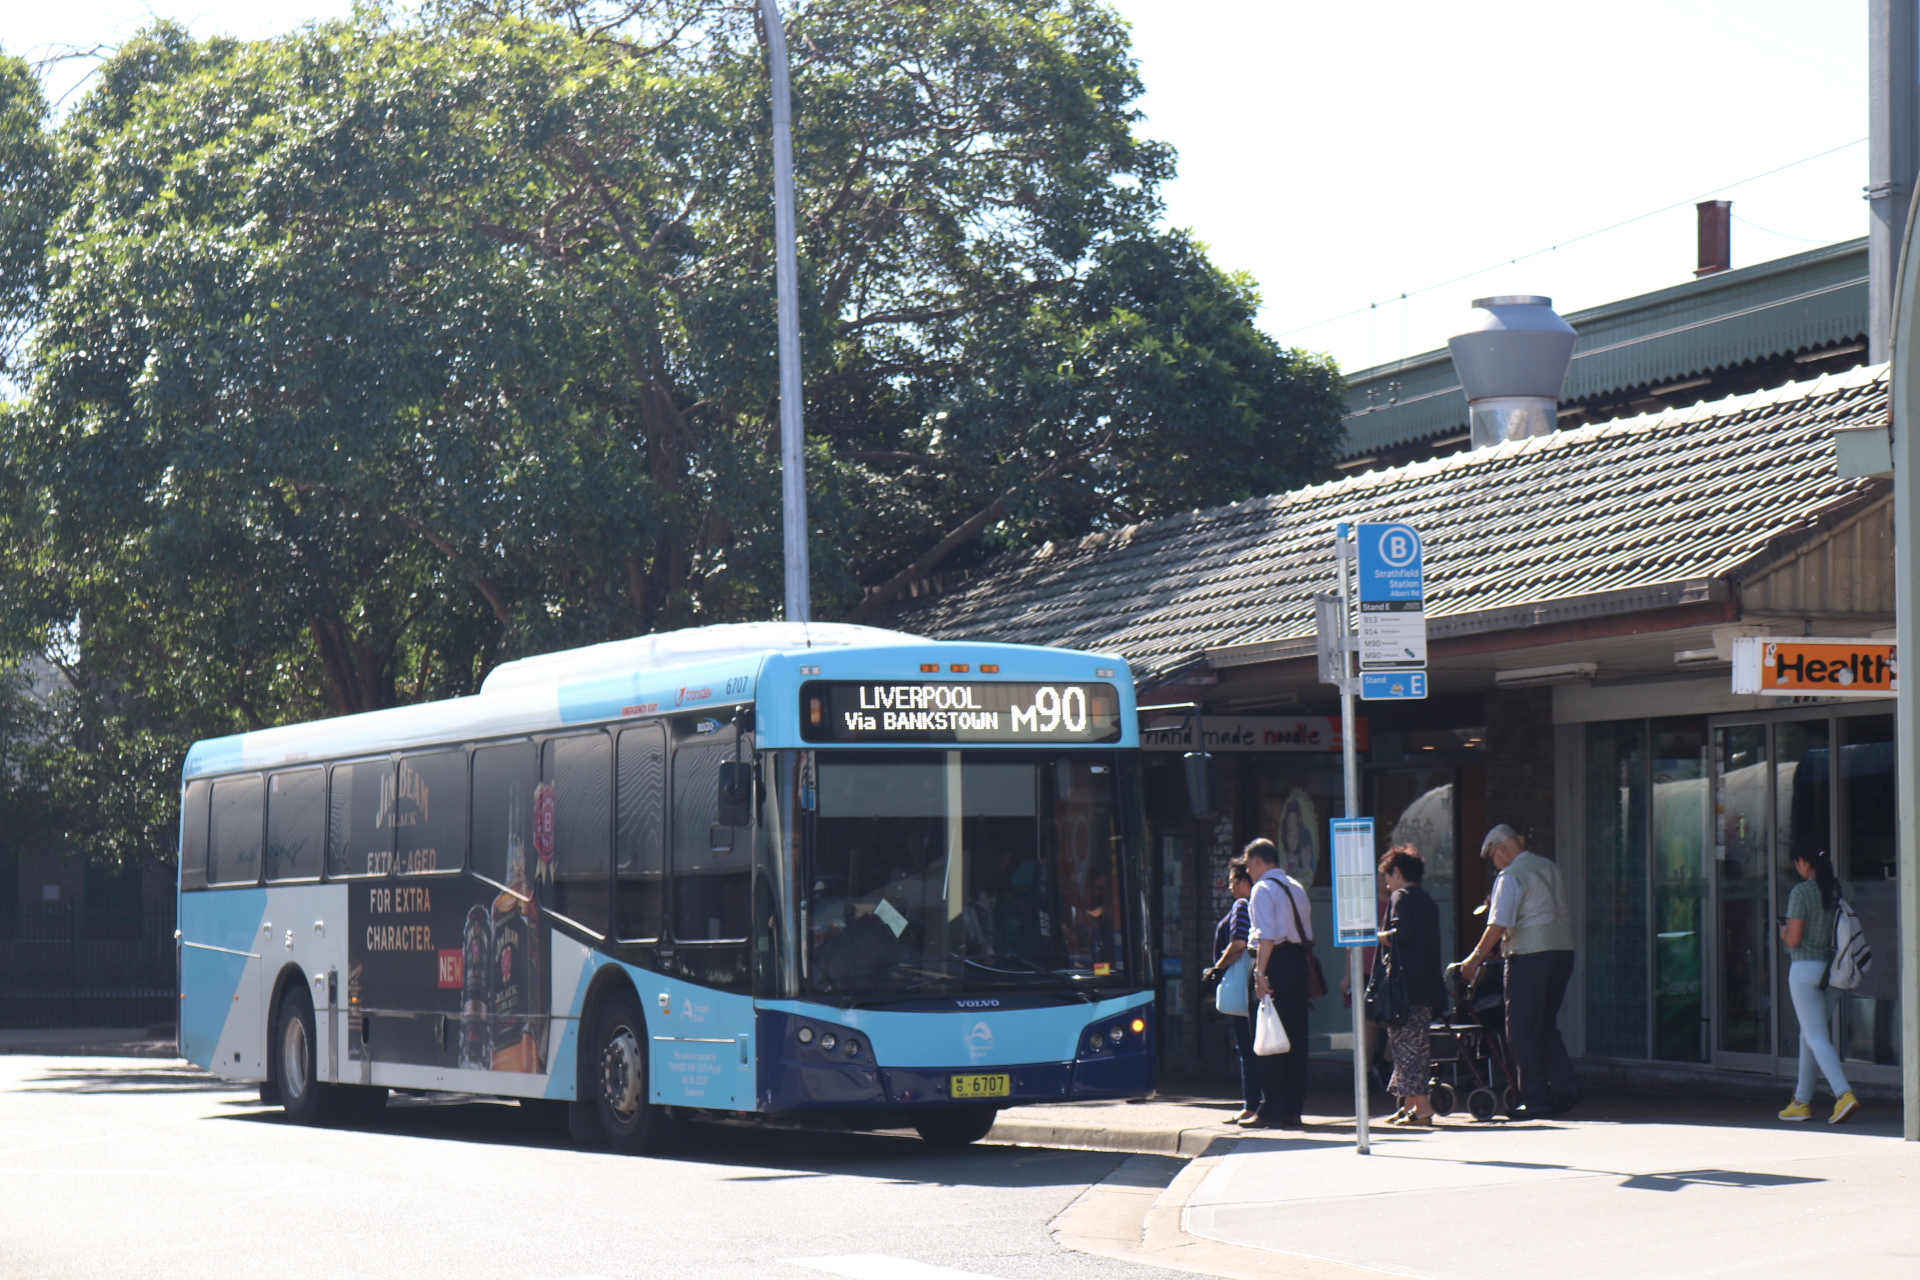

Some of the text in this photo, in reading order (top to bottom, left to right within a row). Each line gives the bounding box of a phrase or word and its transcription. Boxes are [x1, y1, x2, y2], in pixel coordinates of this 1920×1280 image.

[1391, 536, 1407, 559] B
[1374, 569, 1419, 579] Strathfield
[1389, 579, 1420, 589] Station
[1390, 590, 1410, 598] Albert
[1362, 602, 1391, 611] Stand E
[1363, 616, 1378, 624] 913
[1364, 628, 1378, 636] 914
[1364, 640, 1381, 648] M90
[1365, 652, 1382, 660] M90
[686, 685, 713, 701] transdev
[726, 675, 749, 696] 6707
[1365, 675, 1422, 695] Stand E
[860, 686, 982, 709] LIVERPOOL
[1011, 686, 1086, 732] M90
[845, 711, 998, 731] Via BANKSTOWN
[1146, 723, 1321, 745] hand made noodle
[376, 759, 429, 830] JIM BEAM
[367, 848, 437, 876] EXTRA-AGED
[370, 887, 431, 913] FOR EXTRA
[366, 925, 435, 951] CHARACTER.
[439, 955, 462, 982] NEW
[956, 999, 1000, 1008] VOLVO
[973, 1076, 1004, 1092] 6707
